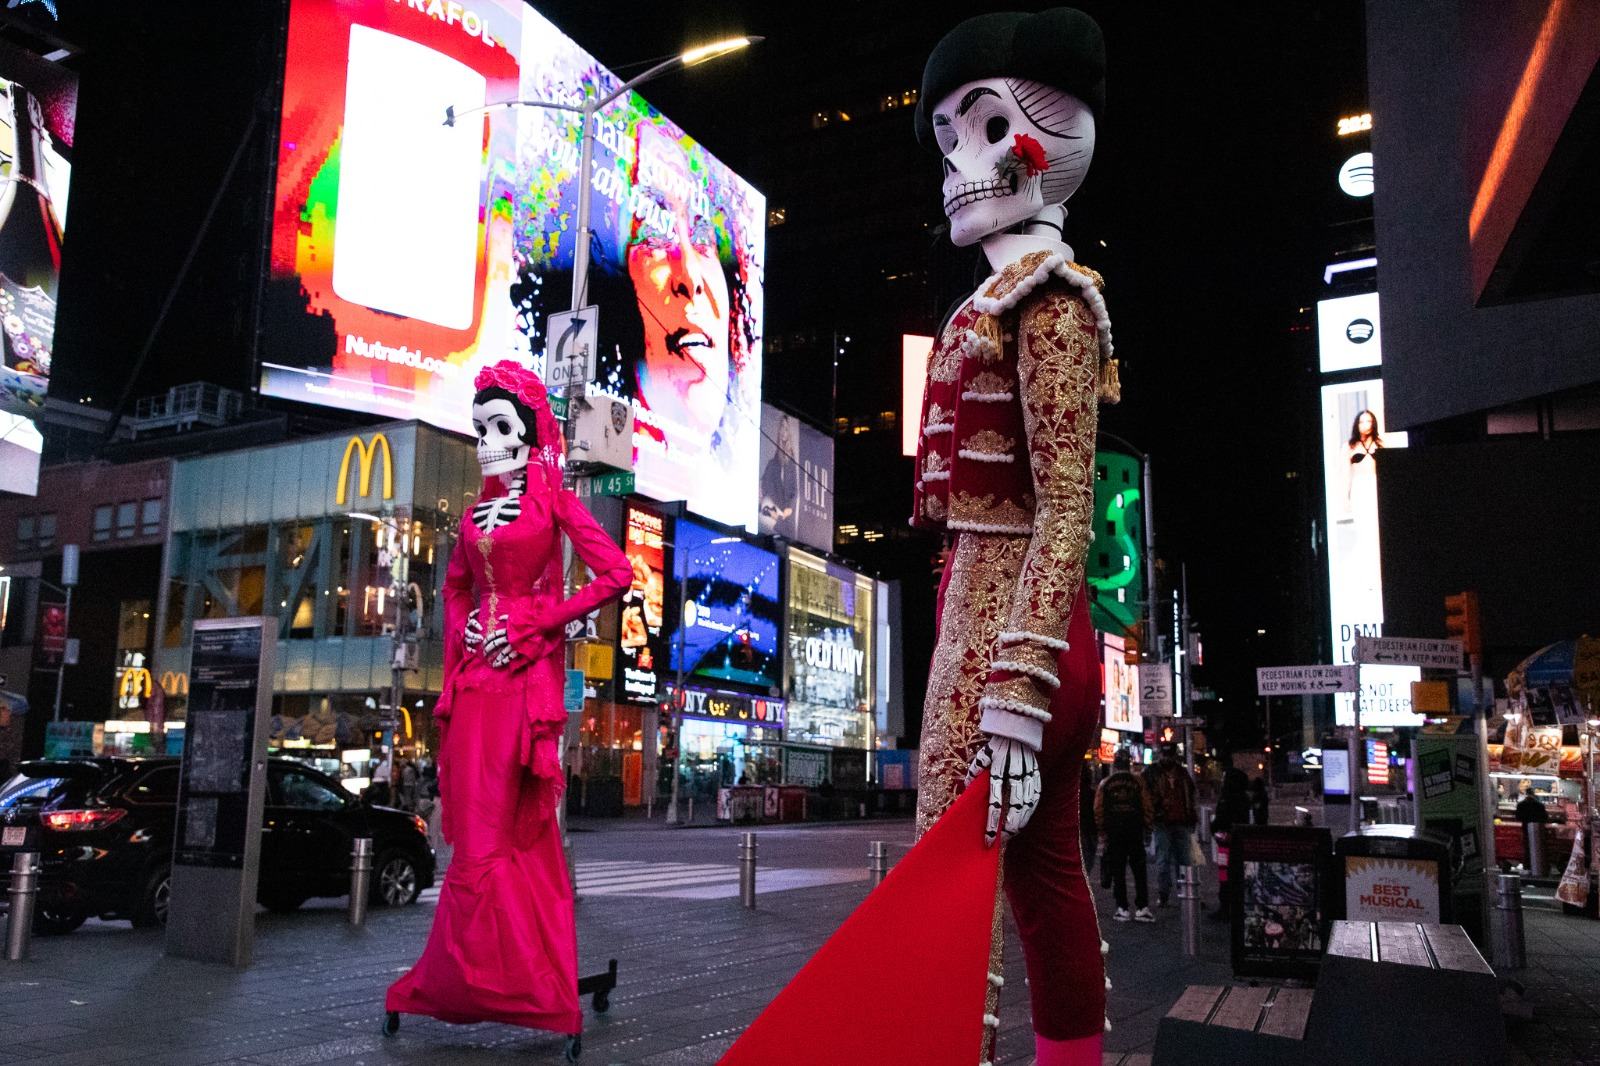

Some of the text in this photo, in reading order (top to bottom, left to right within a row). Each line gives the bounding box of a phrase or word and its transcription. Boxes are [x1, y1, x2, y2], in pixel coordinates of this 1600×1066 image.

[552, 363, 588, 381] ONLY
[593, 479, 603, 494] W
[608, 477, 621, 493] 45
[1373, 640, 1459, 653] PEDESTRIAN FLOW ZONE
[805, 636, 864, 676] OLD NAVY
[1411, 654, 1459, 664] KEEP MOVING
[1261, 668, 1342, 680] PEDESTRIAN FLOW ZONE
[1144, 685, 1167, 700] 25
[1262, 681, 1307, 691] KEEP MOVING
[1345, 699, 1374, 713] TAT
[1372, 883, 1410, 897] BEST
[1359, 894, 1425, 909] MUSICAL
